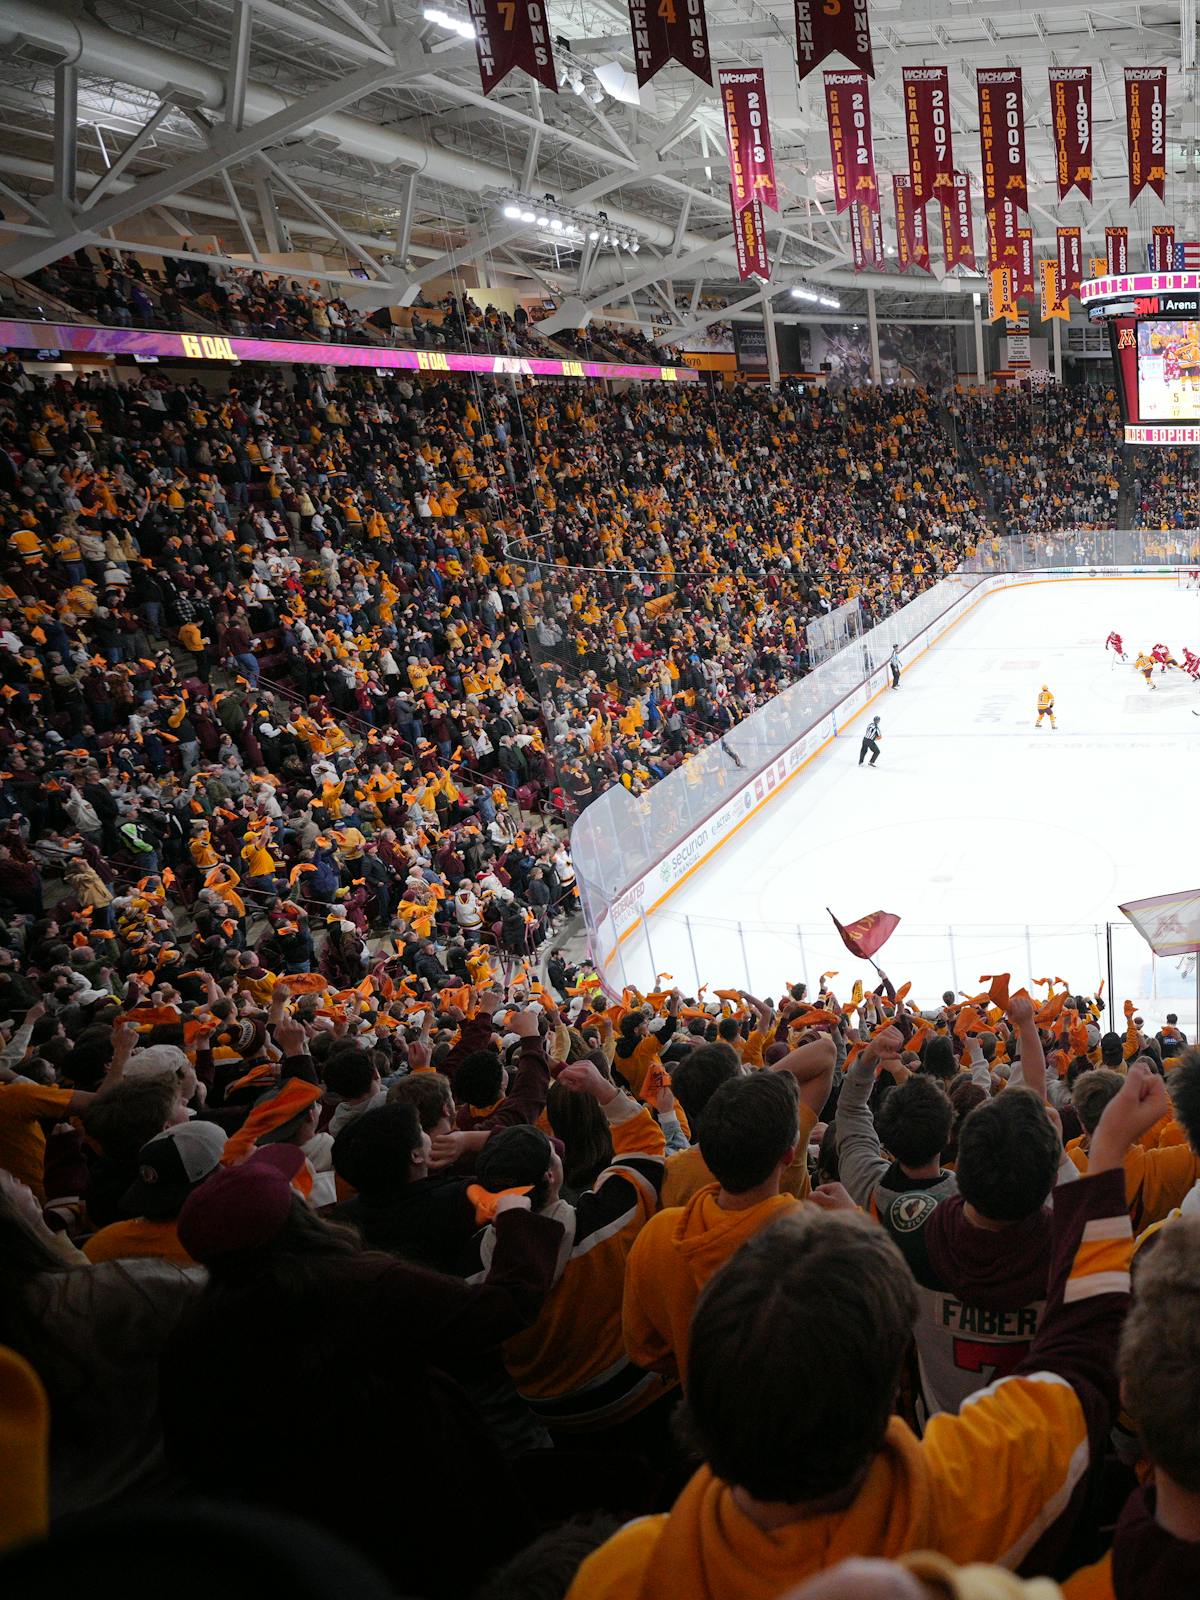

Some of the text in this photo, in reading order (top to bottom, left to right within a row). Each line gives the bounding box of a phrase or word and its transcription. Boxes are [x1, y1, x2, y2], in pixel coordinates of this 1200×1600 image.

[497, 2, 515, 31] 7
[747, 92, 766, 163] 2013
[852, 94, 868, 164] 2012
[907, 86, 924, 196] CHAMPIONS
[932, 90, 946, 162] 2007
[1005, 92, 1021, 164] 2006
[1055, 82, 1068, 185] CHAMPIONS
[1076, 85, 1089, 154] 1997
[1131, 83, 1141, 185] CHAMPIONS
[1151, 85, 1163, 154] 1992
[725, 89, 745, 199] CHAMPIONS
[830, 90, 847, 199] CHAMPIONS
[981, 88, 995, 198] CHAMPIONS
[743, 211, 755, 256] 2021
[957, 190, 968, 238] 2023
[1004, 196, 1014, 238] 022
[1152, 226, 1175, 234] NCAA
[1071, 238, 1079, 272] 2014
[1085, 278, 1134, 297] GOLDEN
[1134, 297, 1158, 314] 3M
[1166, 300, 1196, 309] Arena
[180, 335, 239, 360] GOAL
[417, 351, 450, 371] GOAL
[562, 360, 585, 377] GOAL
[1174, 393, 1179, 402] 5
[1152, 429, 1200, 441] GOPHER
[671, 829, 709, 871] securian
[943, 1300, 1038, 1336] FABER
